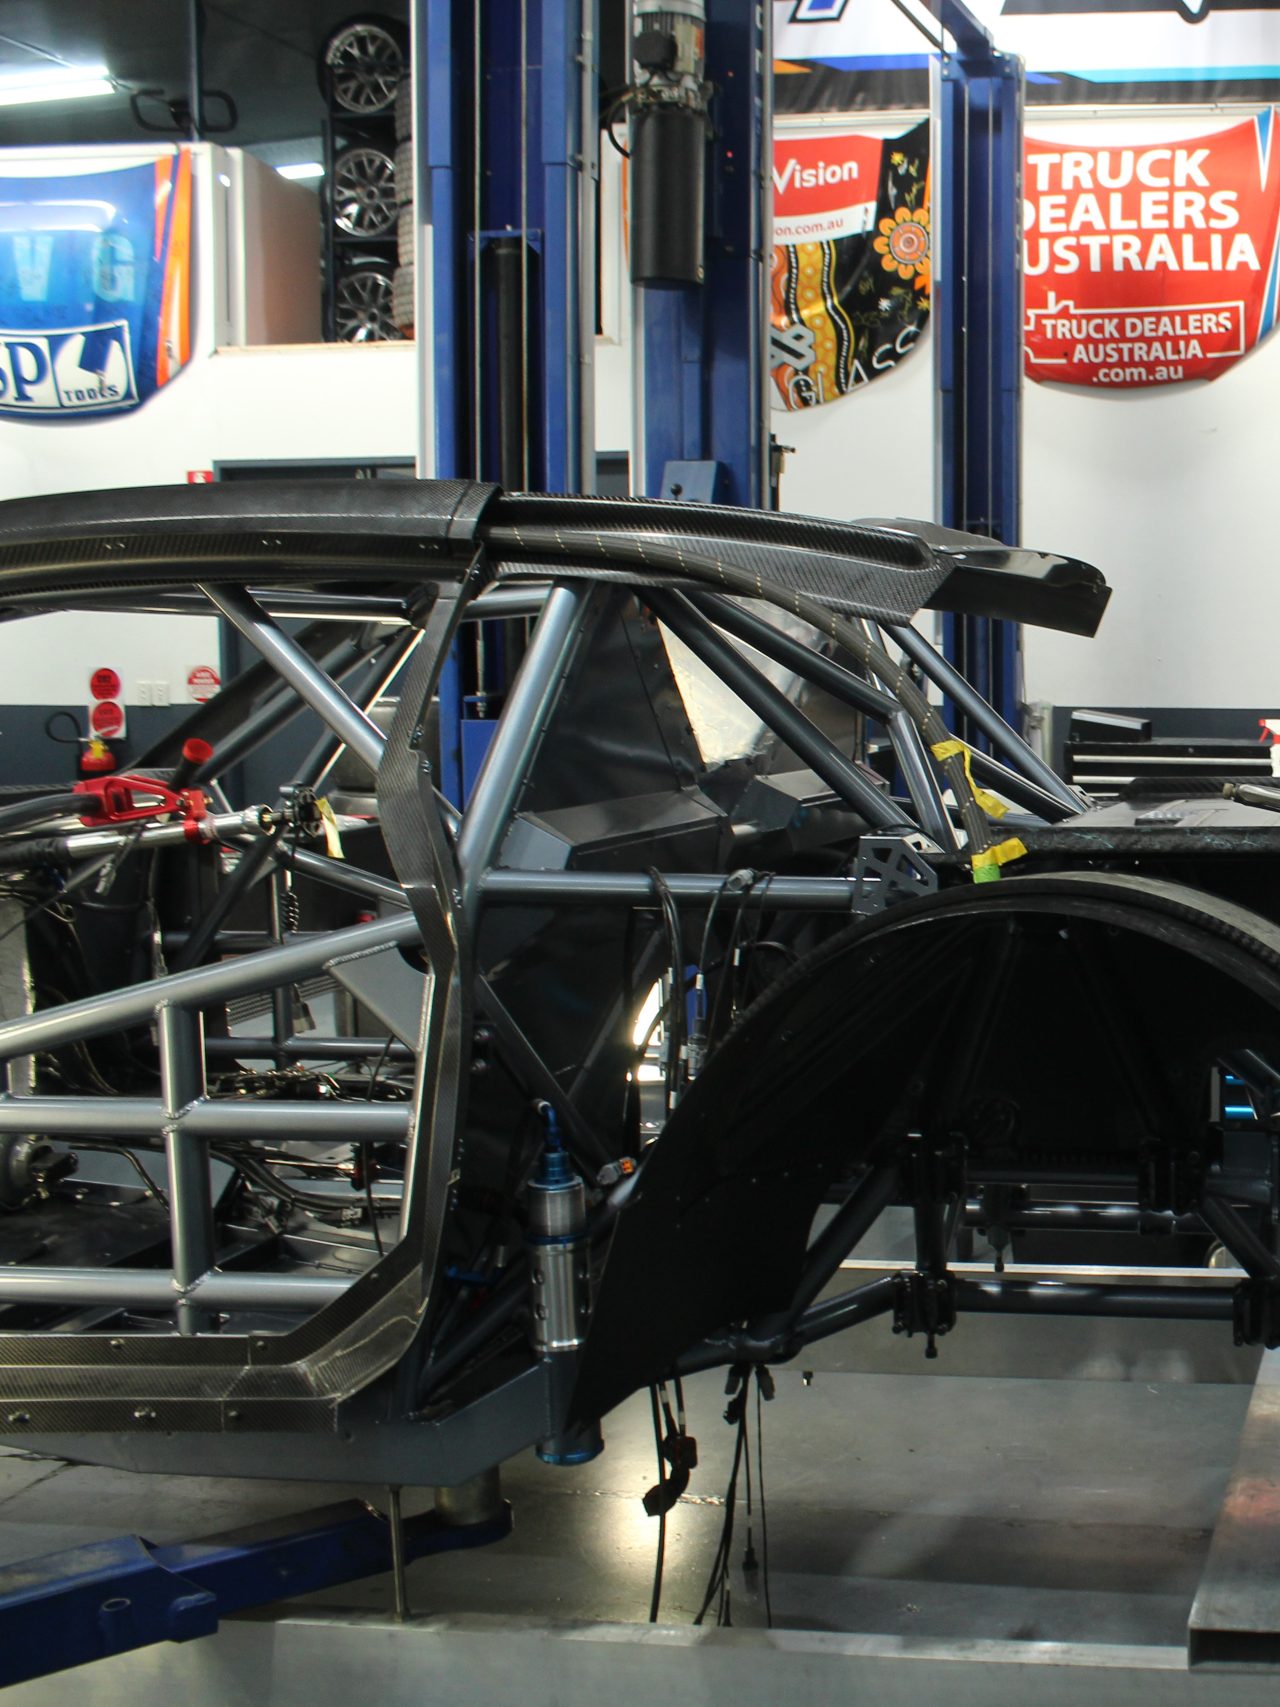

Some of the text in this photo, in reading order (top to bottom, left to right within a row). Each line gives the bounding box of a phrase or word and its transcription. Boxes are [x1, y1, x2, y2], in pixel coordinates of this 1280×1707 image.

[1026, 149, 1211, 191] TRUCK
[1024, 233, 1261, 276] USTRALIA
[1041, 312, 1232, 339] TRUCK DEALERS
[1072, 340, 1203, 363] AUSTRALIA
[1092, 365, 1184, 383] .com.au
